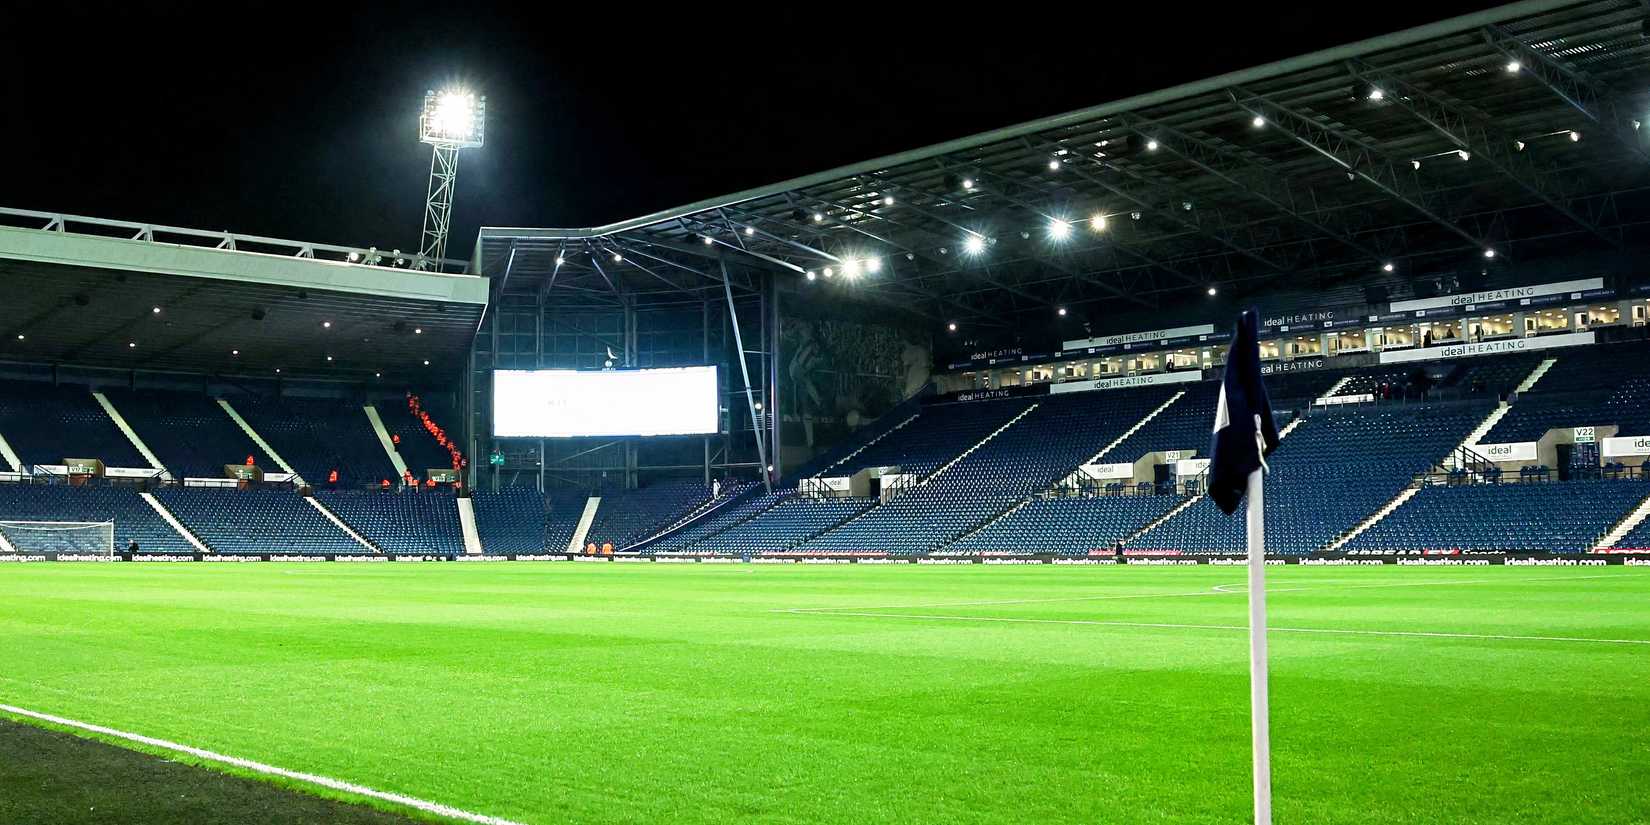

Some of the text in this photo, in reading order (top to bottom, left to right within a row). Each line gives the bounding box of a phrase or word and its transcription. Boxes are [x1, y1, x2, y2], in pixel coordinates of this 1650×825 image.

[1451, 287, 1534, 305] ideal HEATING
[1264, 316, 1285, 326] ideal
[1286, 311, 1334, 323] HEATING
[1106, 331, 1166, 344] ideal HEATING
[1441, 340, 1525, 357] ideal HEATING
[1260, 360, 1323, 374] eal HEATING
[1094, 376, 1154, 389] ideal HEATING
[974, 390, 1009, 399] HEATING
[1576, 428, 1594, 436] V22
[1488, 445, 1512, 454] ideal
[1195, 460, 1206, 468] ide
[1097, 465, 1114, 474] ideal
[1127, 557, 1197, 565] idealheatingcom
[1299, 557, 1383, 565] idealheatingcom
[1397, 557, 1489, 565] idealheatingcom
[1505, 557, 1606, 565] idealheatingcom
